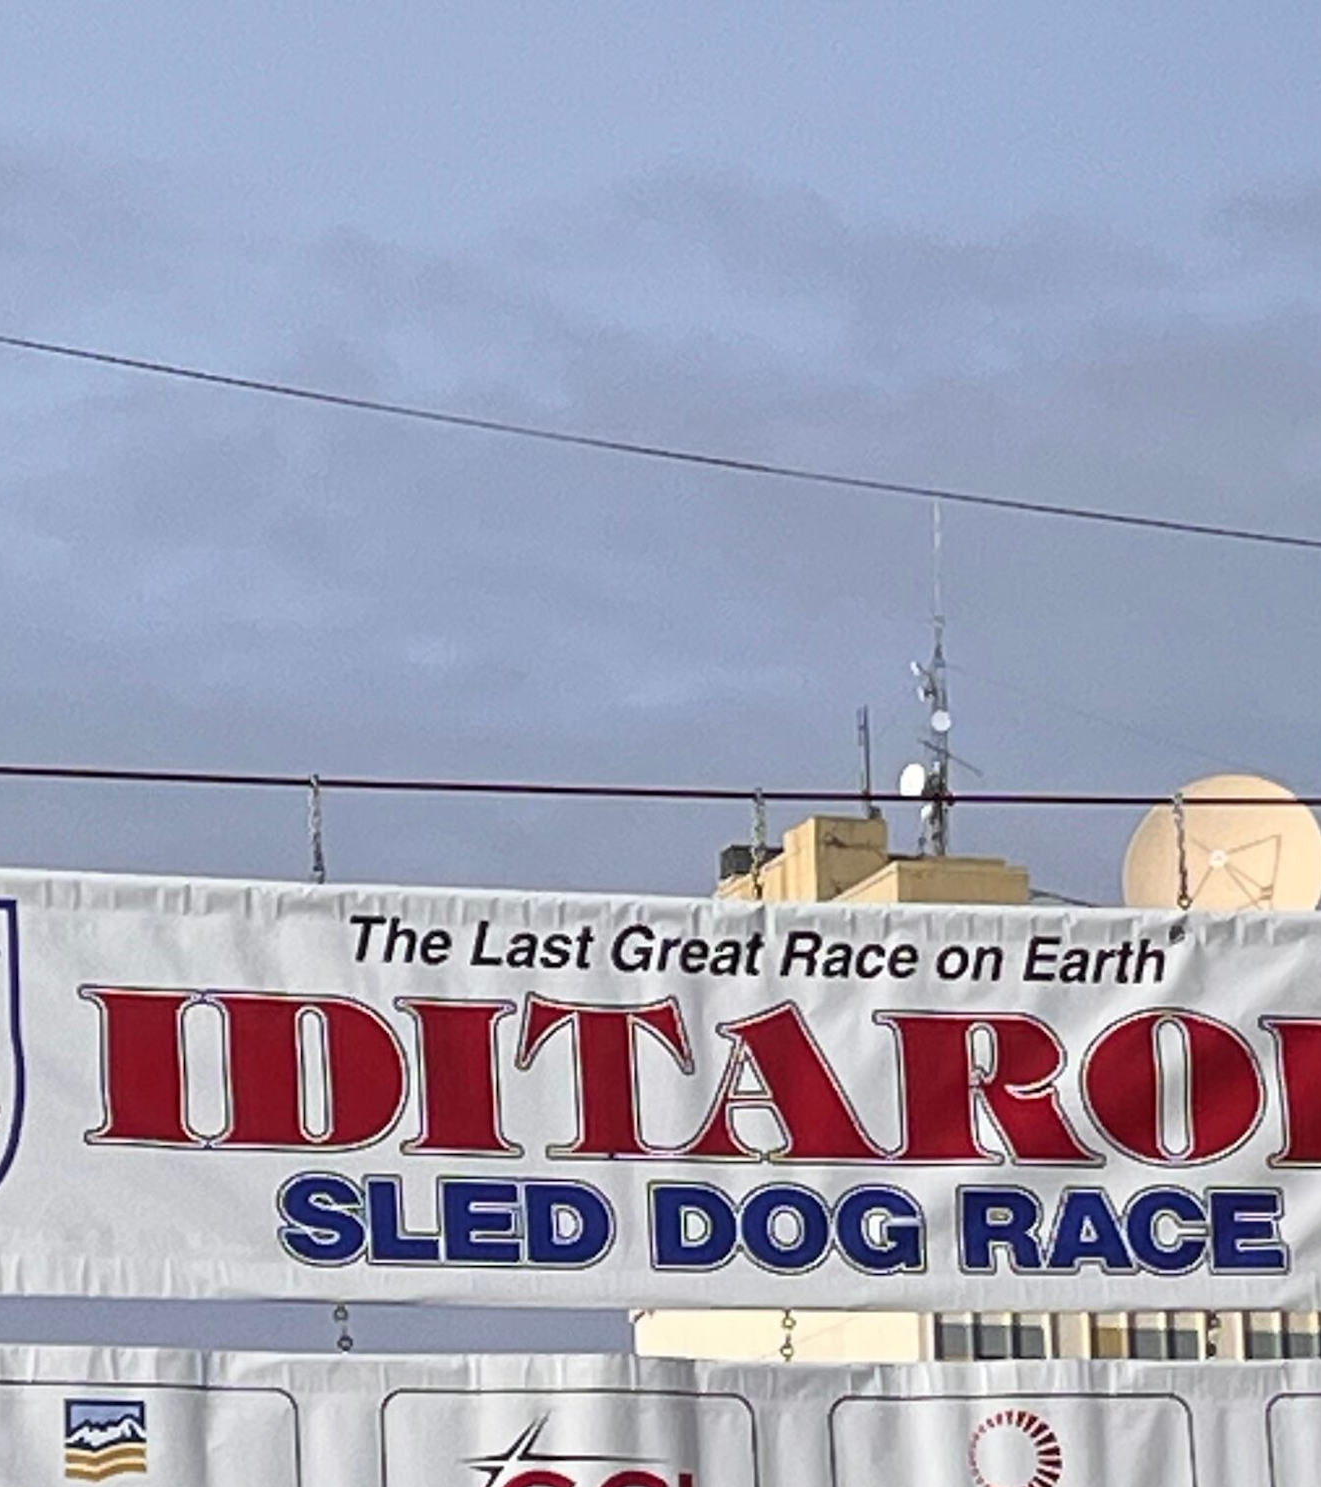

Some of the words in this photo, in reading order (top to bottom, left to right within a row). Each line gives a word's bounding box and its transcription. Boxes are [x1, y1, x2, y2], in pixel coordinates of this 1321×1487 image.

[349, 916, 452, 966] The
[470, 920, 593, 969] Last
[610, 925, 764, 976] Great
[780, 931, 919, 979] Race
[937, 943, 1003, 981] on
[1023, 935, 1166, 985] Earth
[279, 1172, 616, 1272] SLED
[647, 1180, 926, 1275] DOG
[955, 1185, 1289, 1276] RACE
